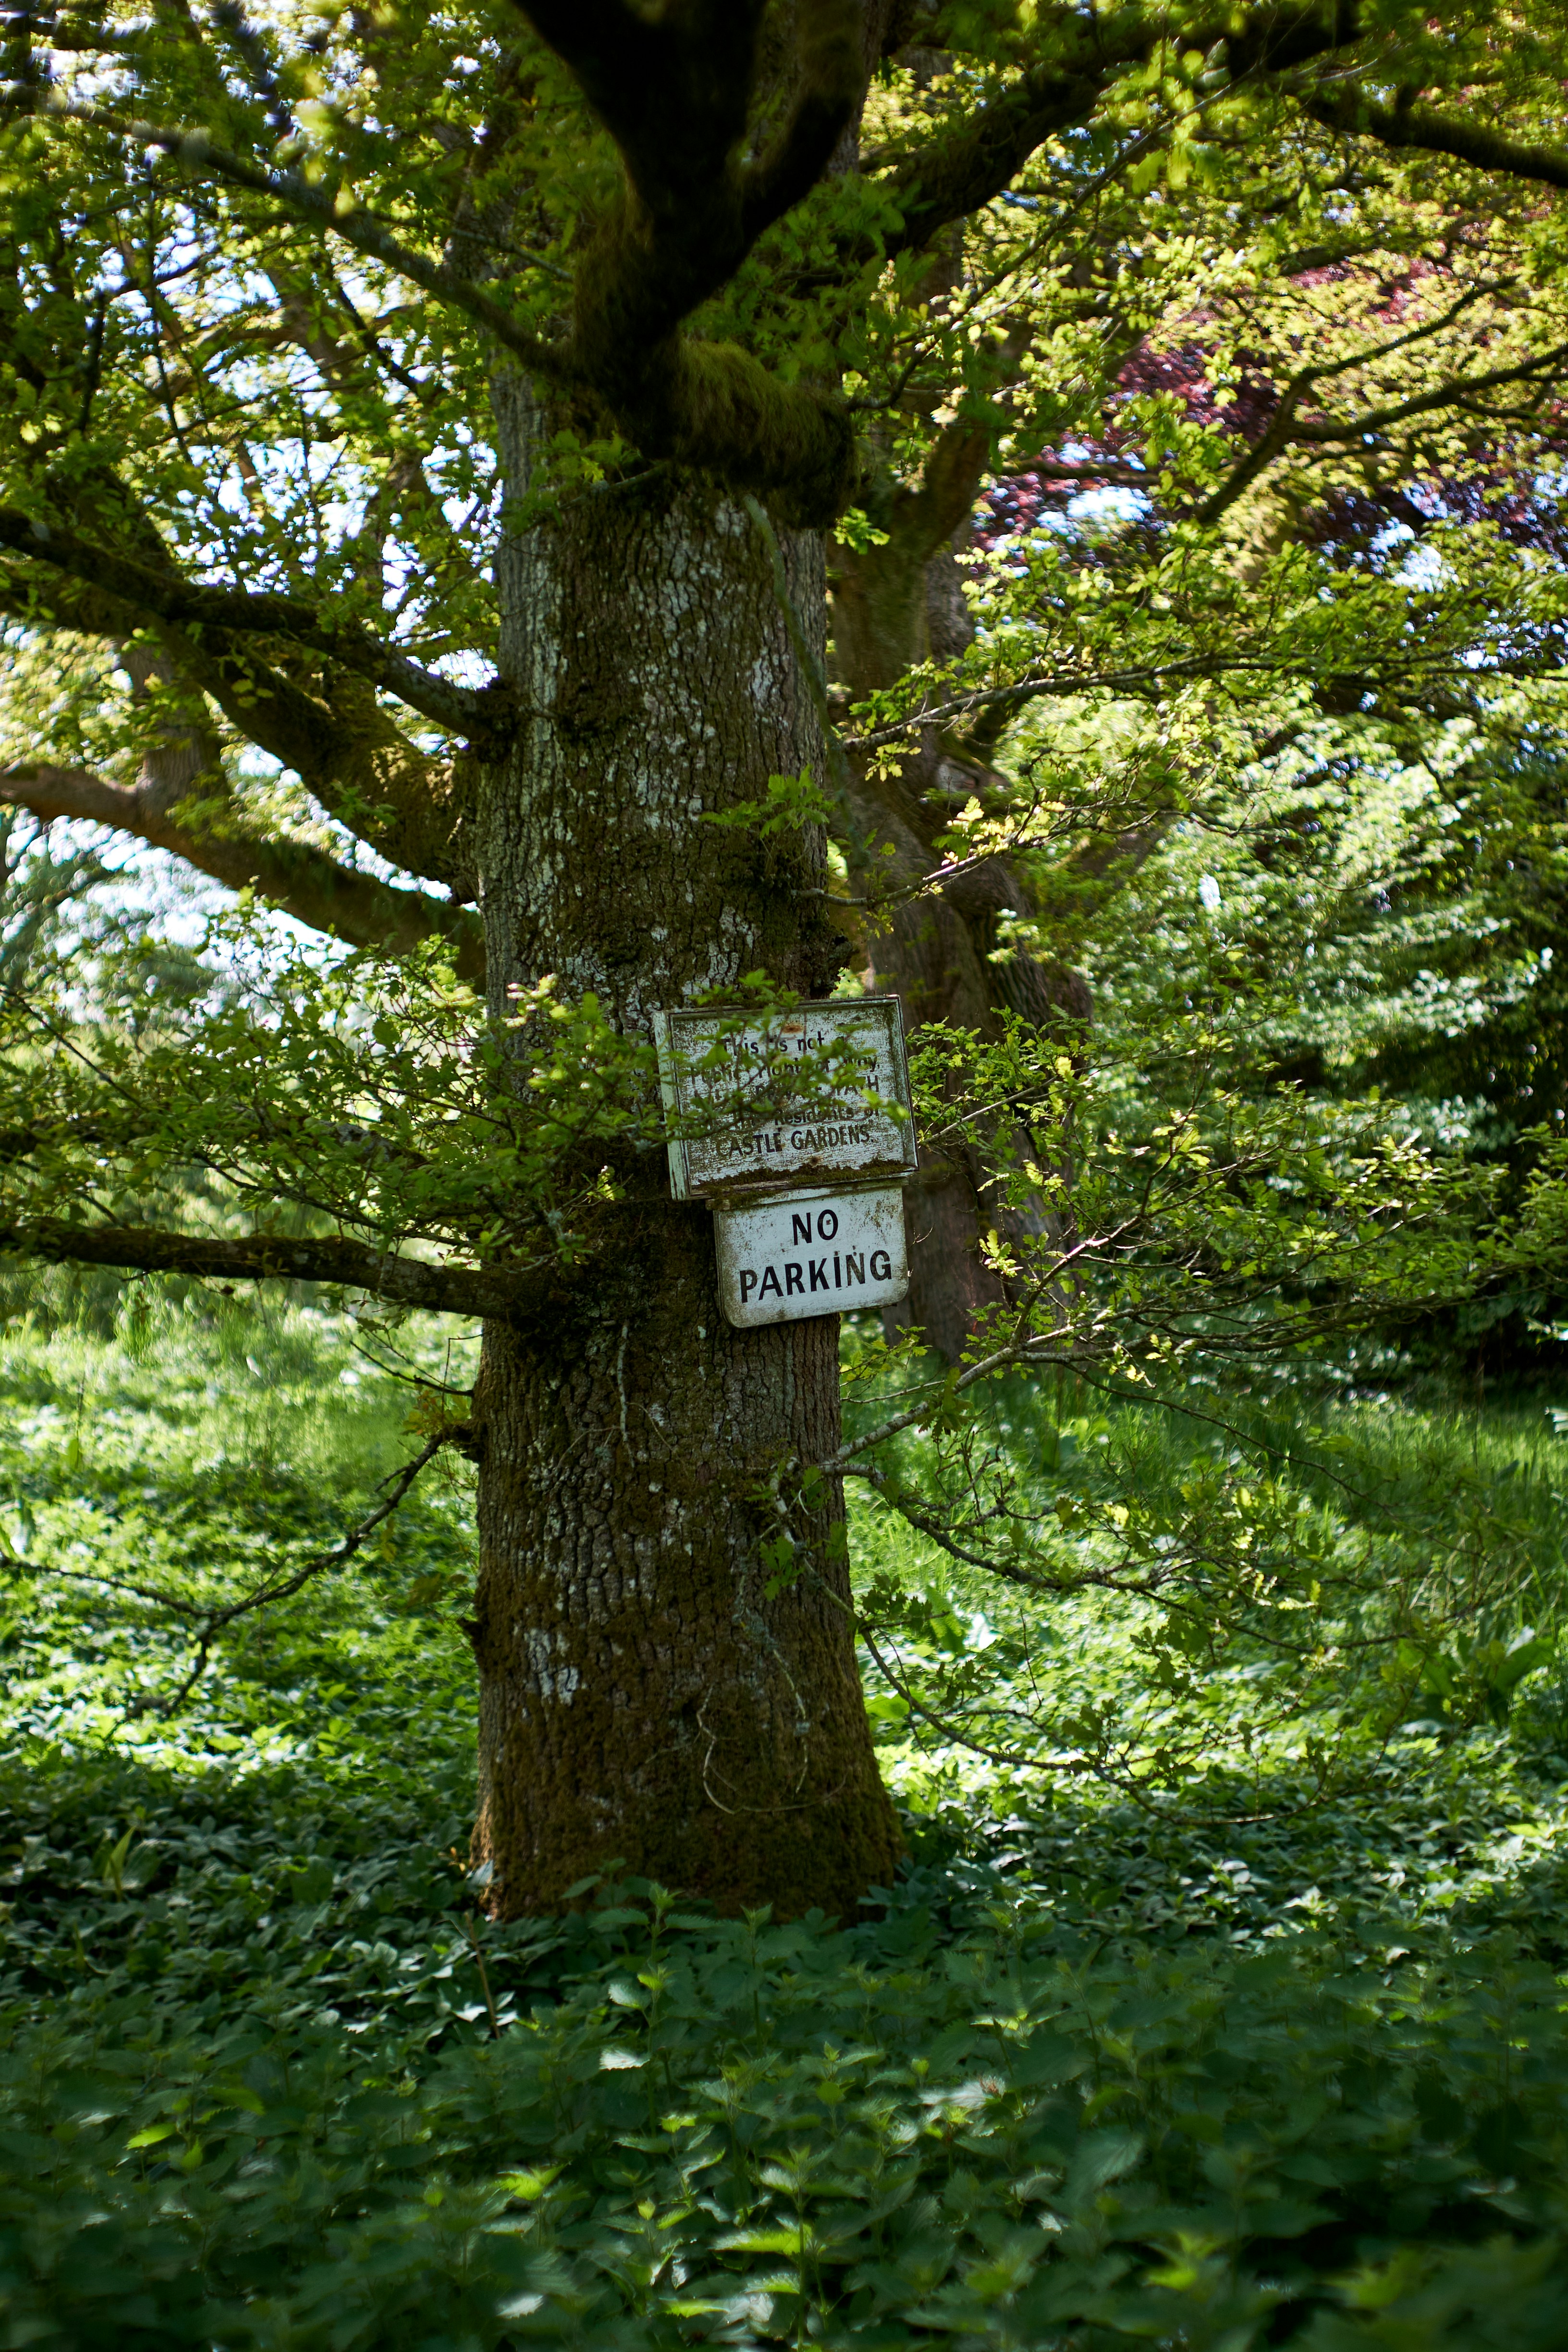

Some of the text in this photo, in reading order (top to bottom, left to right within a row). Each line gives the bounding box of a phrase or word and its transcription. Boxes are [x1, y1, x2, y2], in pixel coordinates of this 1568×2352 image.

[797, 1031, 825, 1051] not
[758, 1058, 801, 1079] rght
[773, 1104, 855, 1126] Residnts
[716, 1132, 783, 1157] CASTLE
[792, 1209, 839, 1245] NO
[739, 1250, 893, 1304] PARKING
